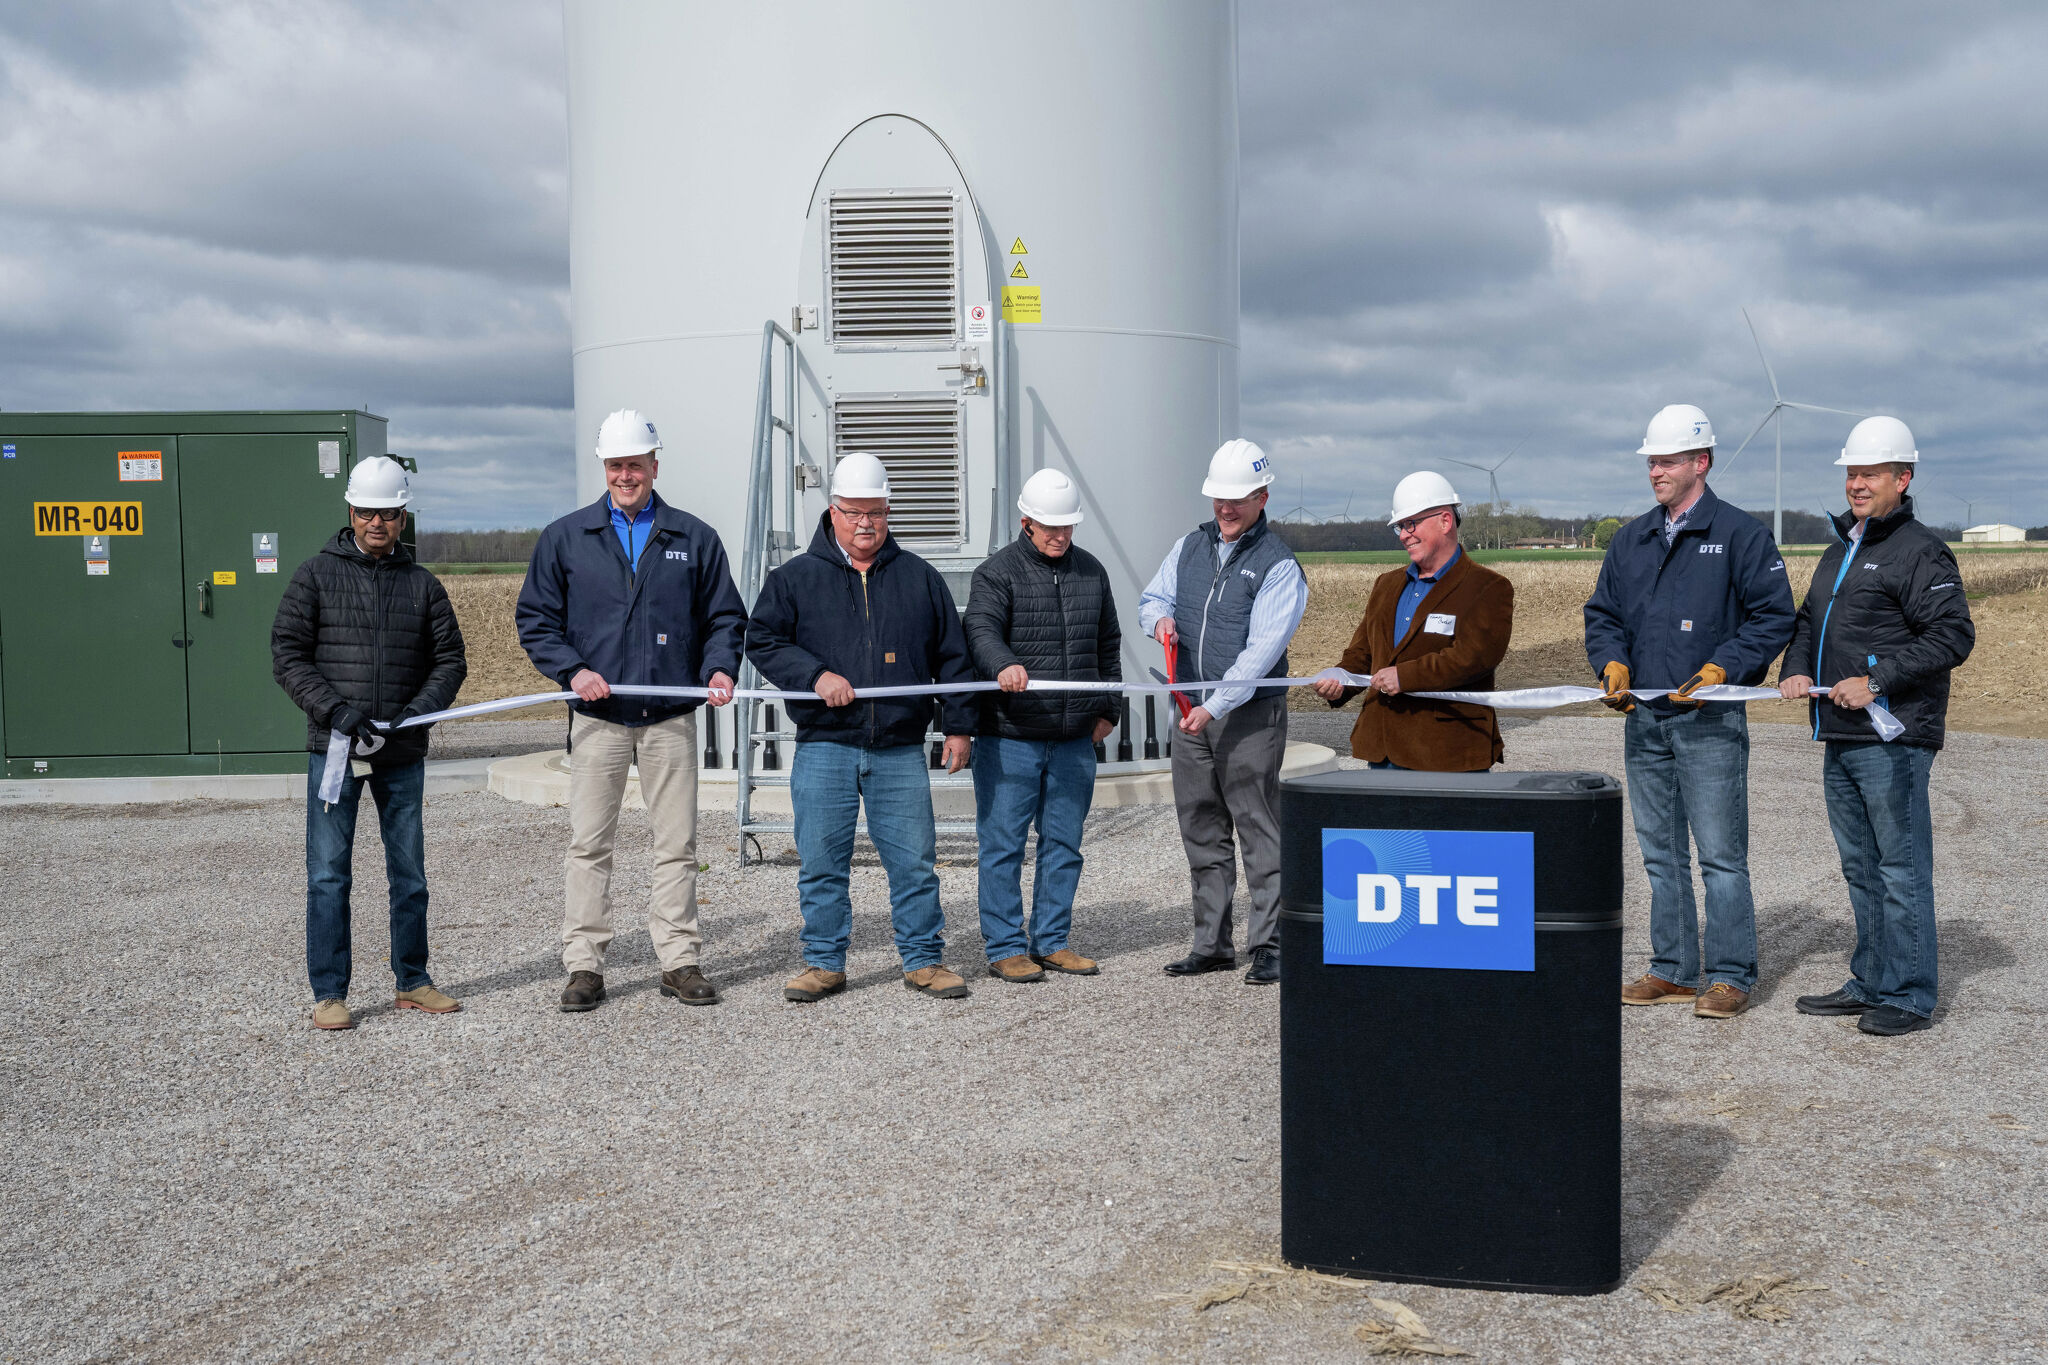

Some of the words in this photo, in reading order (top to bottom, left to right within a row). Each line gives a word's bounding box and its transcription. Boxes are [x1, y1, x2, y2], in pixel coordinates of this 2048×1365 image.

[38, 505, 139, 532] MR-040
[1699, 544, 1723, 554] DTE
[665, 550, 688, 561] DTE
[1240, 569, 1256, 579] DTE
[1357, 873, 1499, 927] DTE
